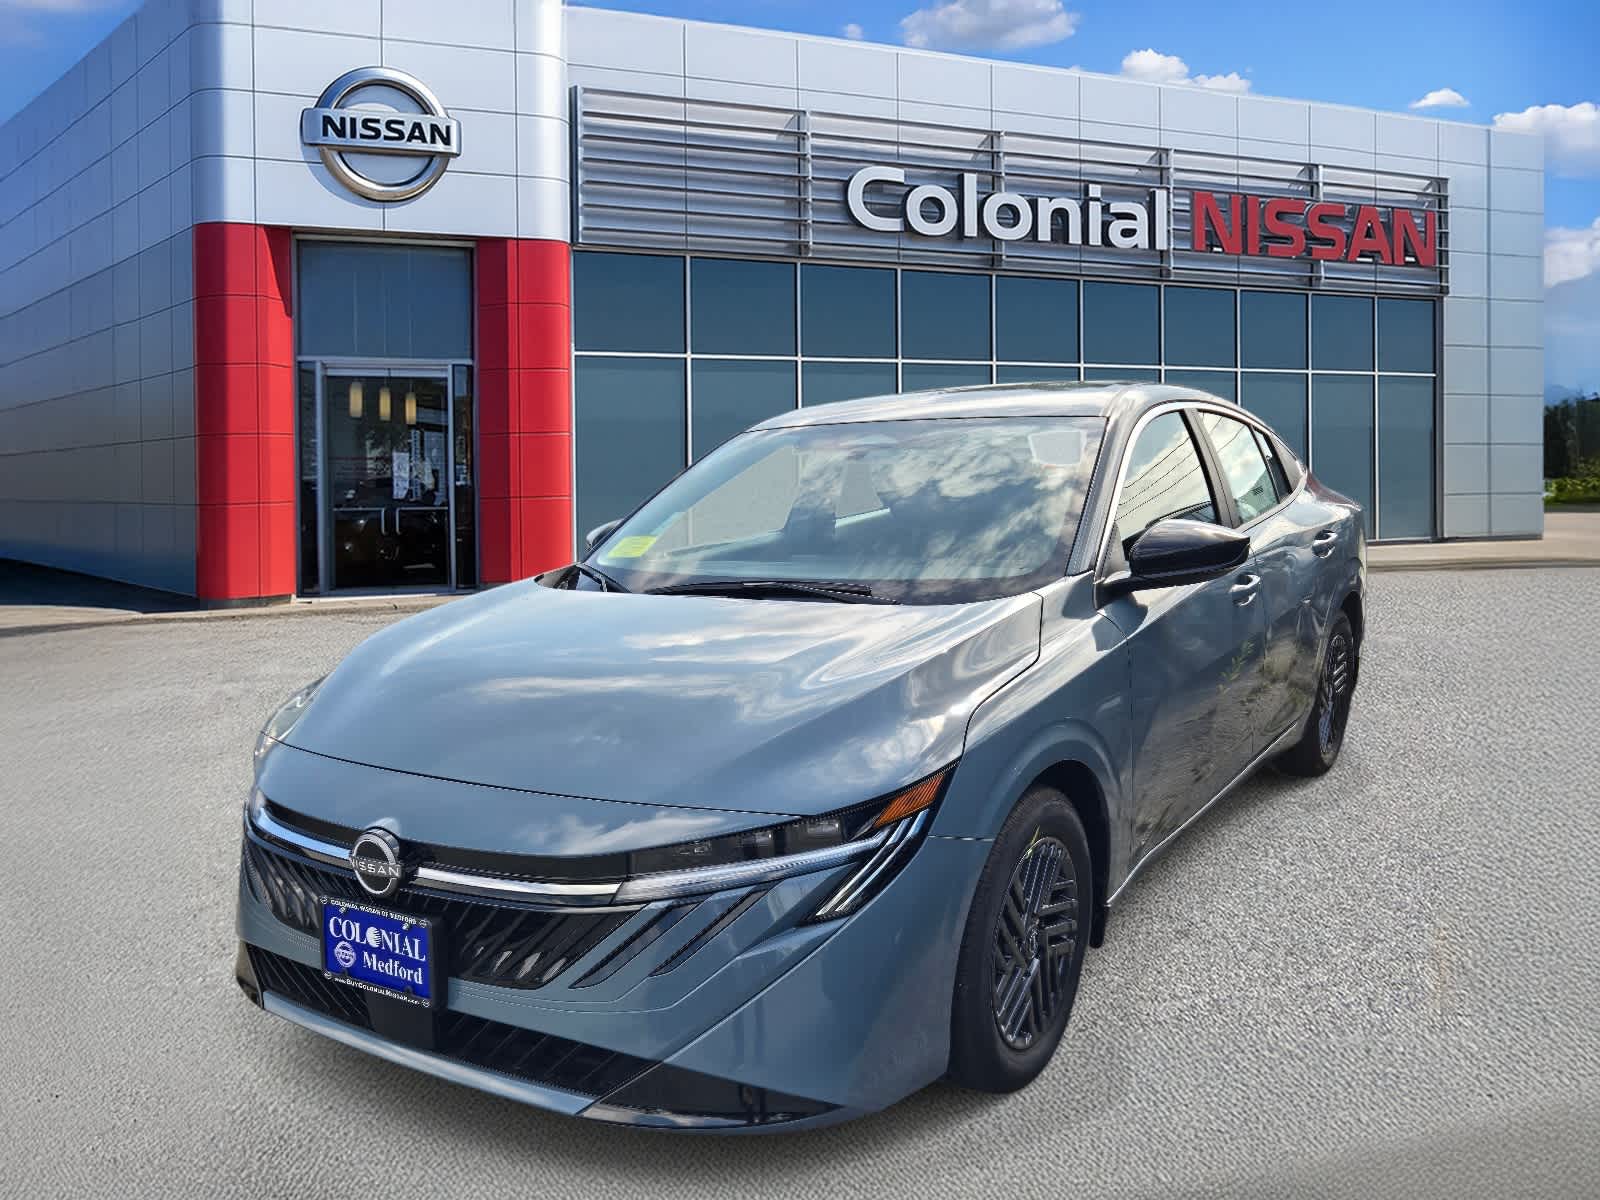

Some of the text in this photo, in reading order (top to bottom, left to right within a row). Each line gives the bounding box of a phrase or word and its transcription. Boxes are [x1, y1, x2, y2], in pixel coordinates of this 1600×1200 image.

[322, 115, 452, 146] NISSAN
[847, 166, 1436, 267] Colonial NISSAN
[329, 916, 426, 962] COLONIAL
[362, 951, 423, 985] Medford
